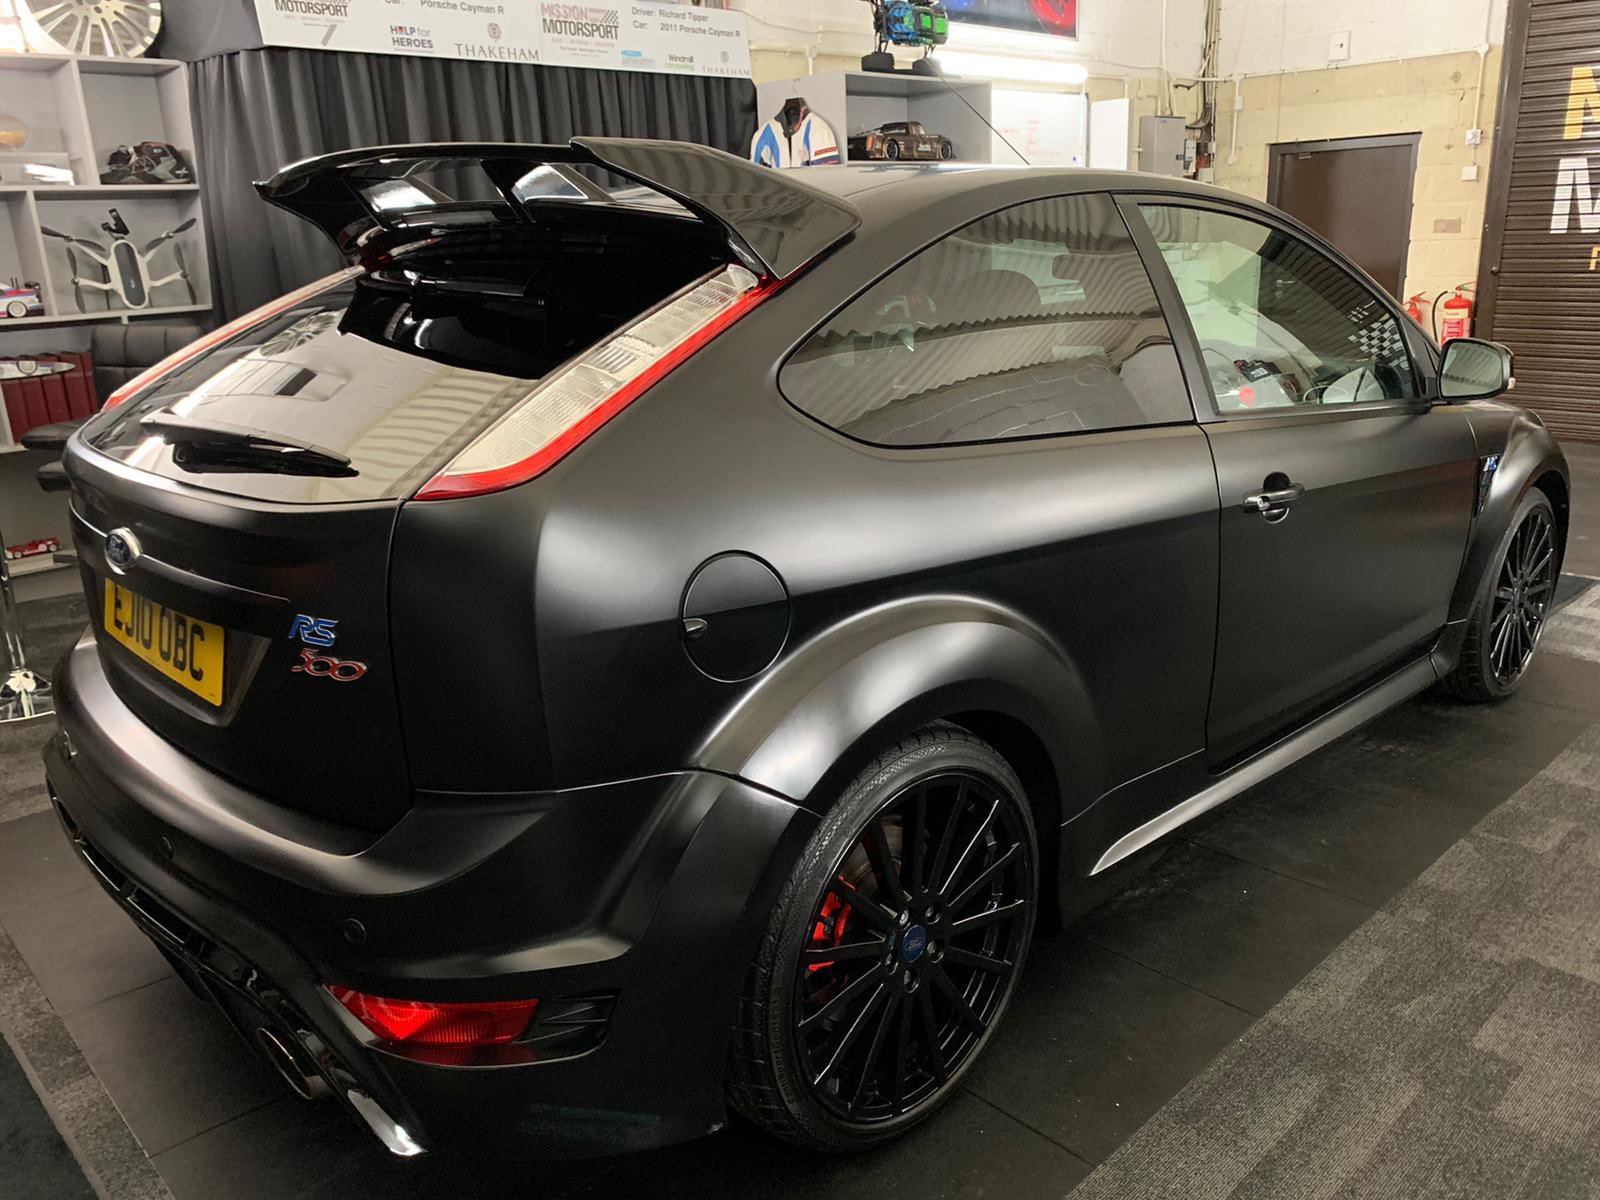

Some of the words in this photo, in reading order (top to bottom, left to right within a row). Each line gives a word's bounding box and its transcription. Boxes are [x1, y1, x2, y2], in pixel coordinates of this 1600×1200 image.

[274, 0, 349, 17] MOTORSPORT
[420, 0, 458, 10] Porsche
[460, 2, 496, 14] Cayman
[498, 6, 505, 14] R
[540, 3, 588, 21] MISSION
[631, 7, 656, 17] Driver:
[658, 9, 687, 19] Richard
[688, 12, 709, 22] Tipper
[542, 18, 620, 40] MOTORSPORT
[632, 20, 648, 29] Car:
[660, 22, 678, 32] 2011
[679, 24, 707, 35] Porsche
[708, 27, 734, 38] Cayman
[735, 30, 741, 38] R
[392, 37, 433, 49] HEROES
[453, 43, 540, 61] THAKEHAM
[114, 583, 153, 650] EJ10
[159, 605, 206, 682] OBC
[288, 614, 340, 647] RS
[290, 647, 367, 682] 500
